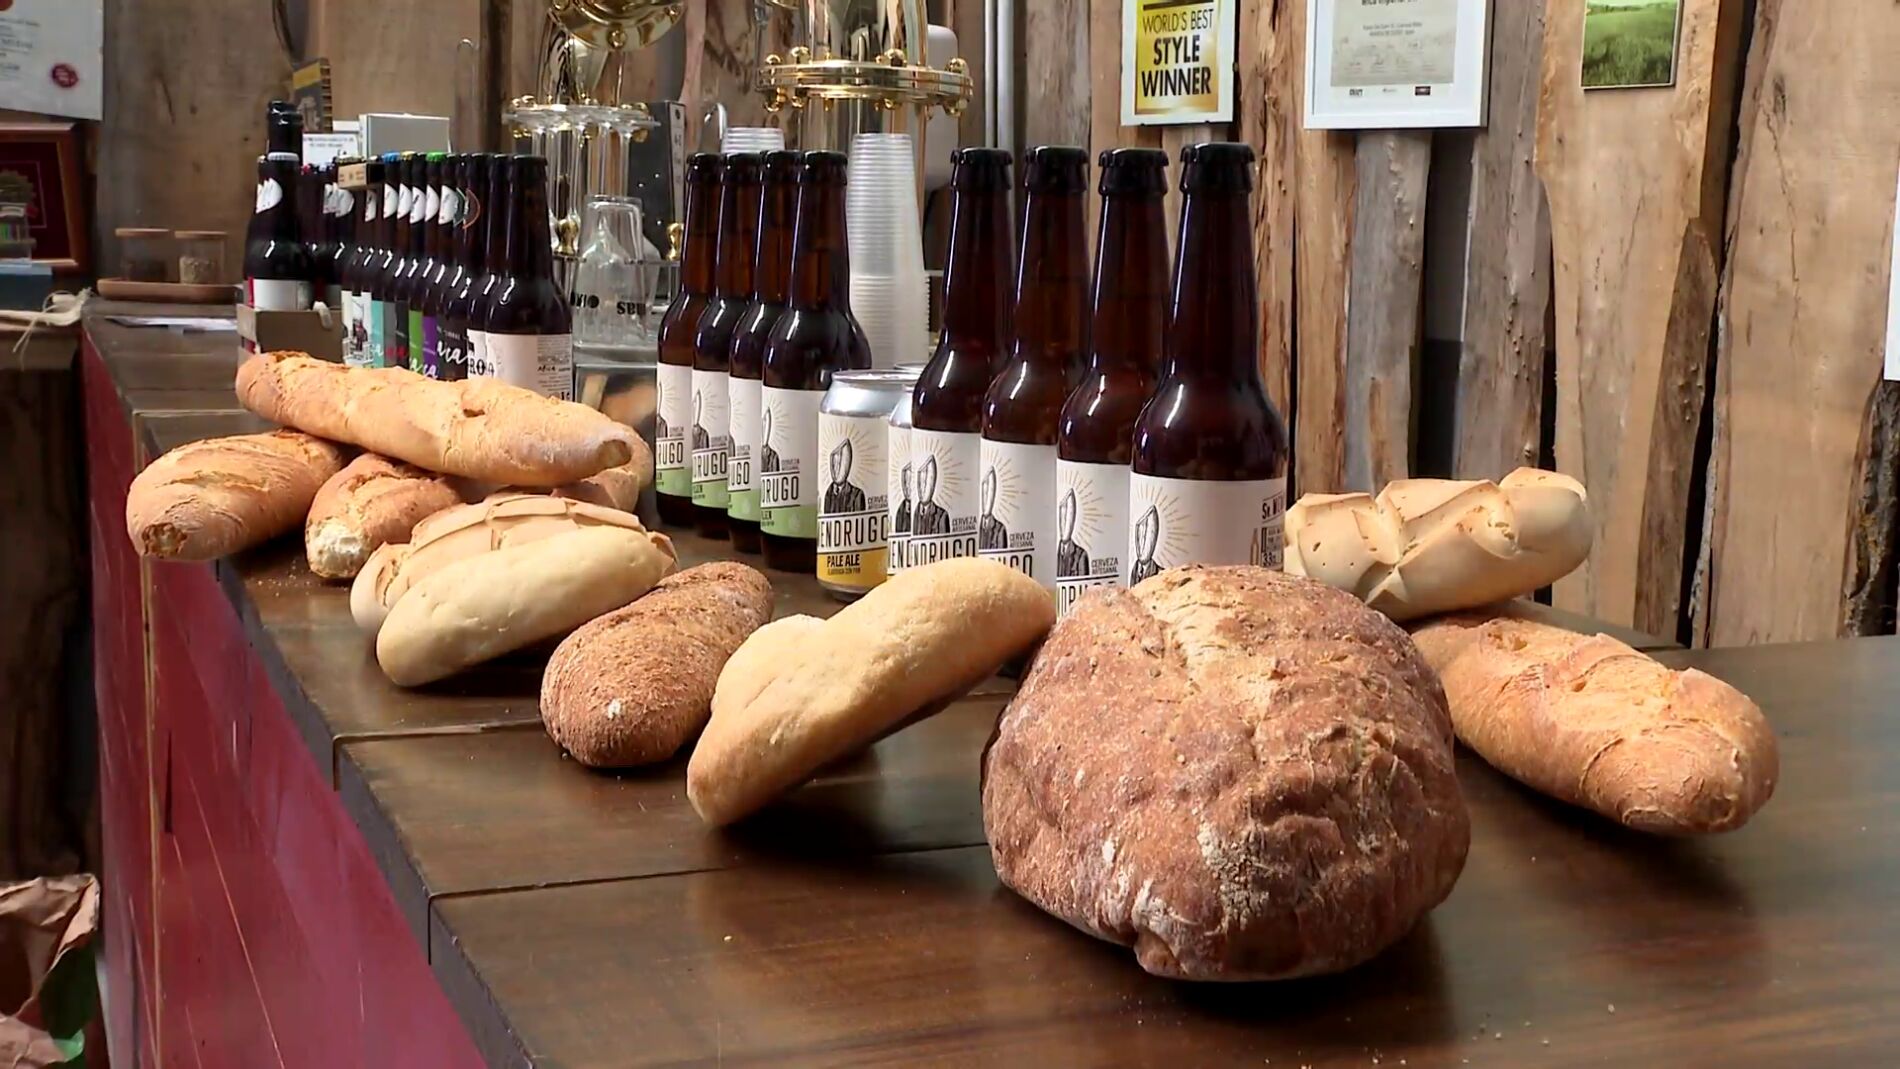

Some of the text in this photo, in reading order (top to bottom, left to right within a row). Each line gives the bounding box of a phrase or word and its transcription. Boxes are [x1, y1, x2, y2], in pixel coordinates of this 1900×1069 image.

[1143, 9, 1214, 34] WORLD'S BEST
[1153, 34, 1200, 65] STYLE
[1141, 66, 1211, 97] WINNER
[868, 495, 888, 504] CERVEZ
[819, 514, 888, 549] ENDRUGO
[1009, 531, 1035, 541] CERVEZA
[827, 554, 860, 568] PALE ALE
[1091, 557, 1119, 568] CERVEZA
